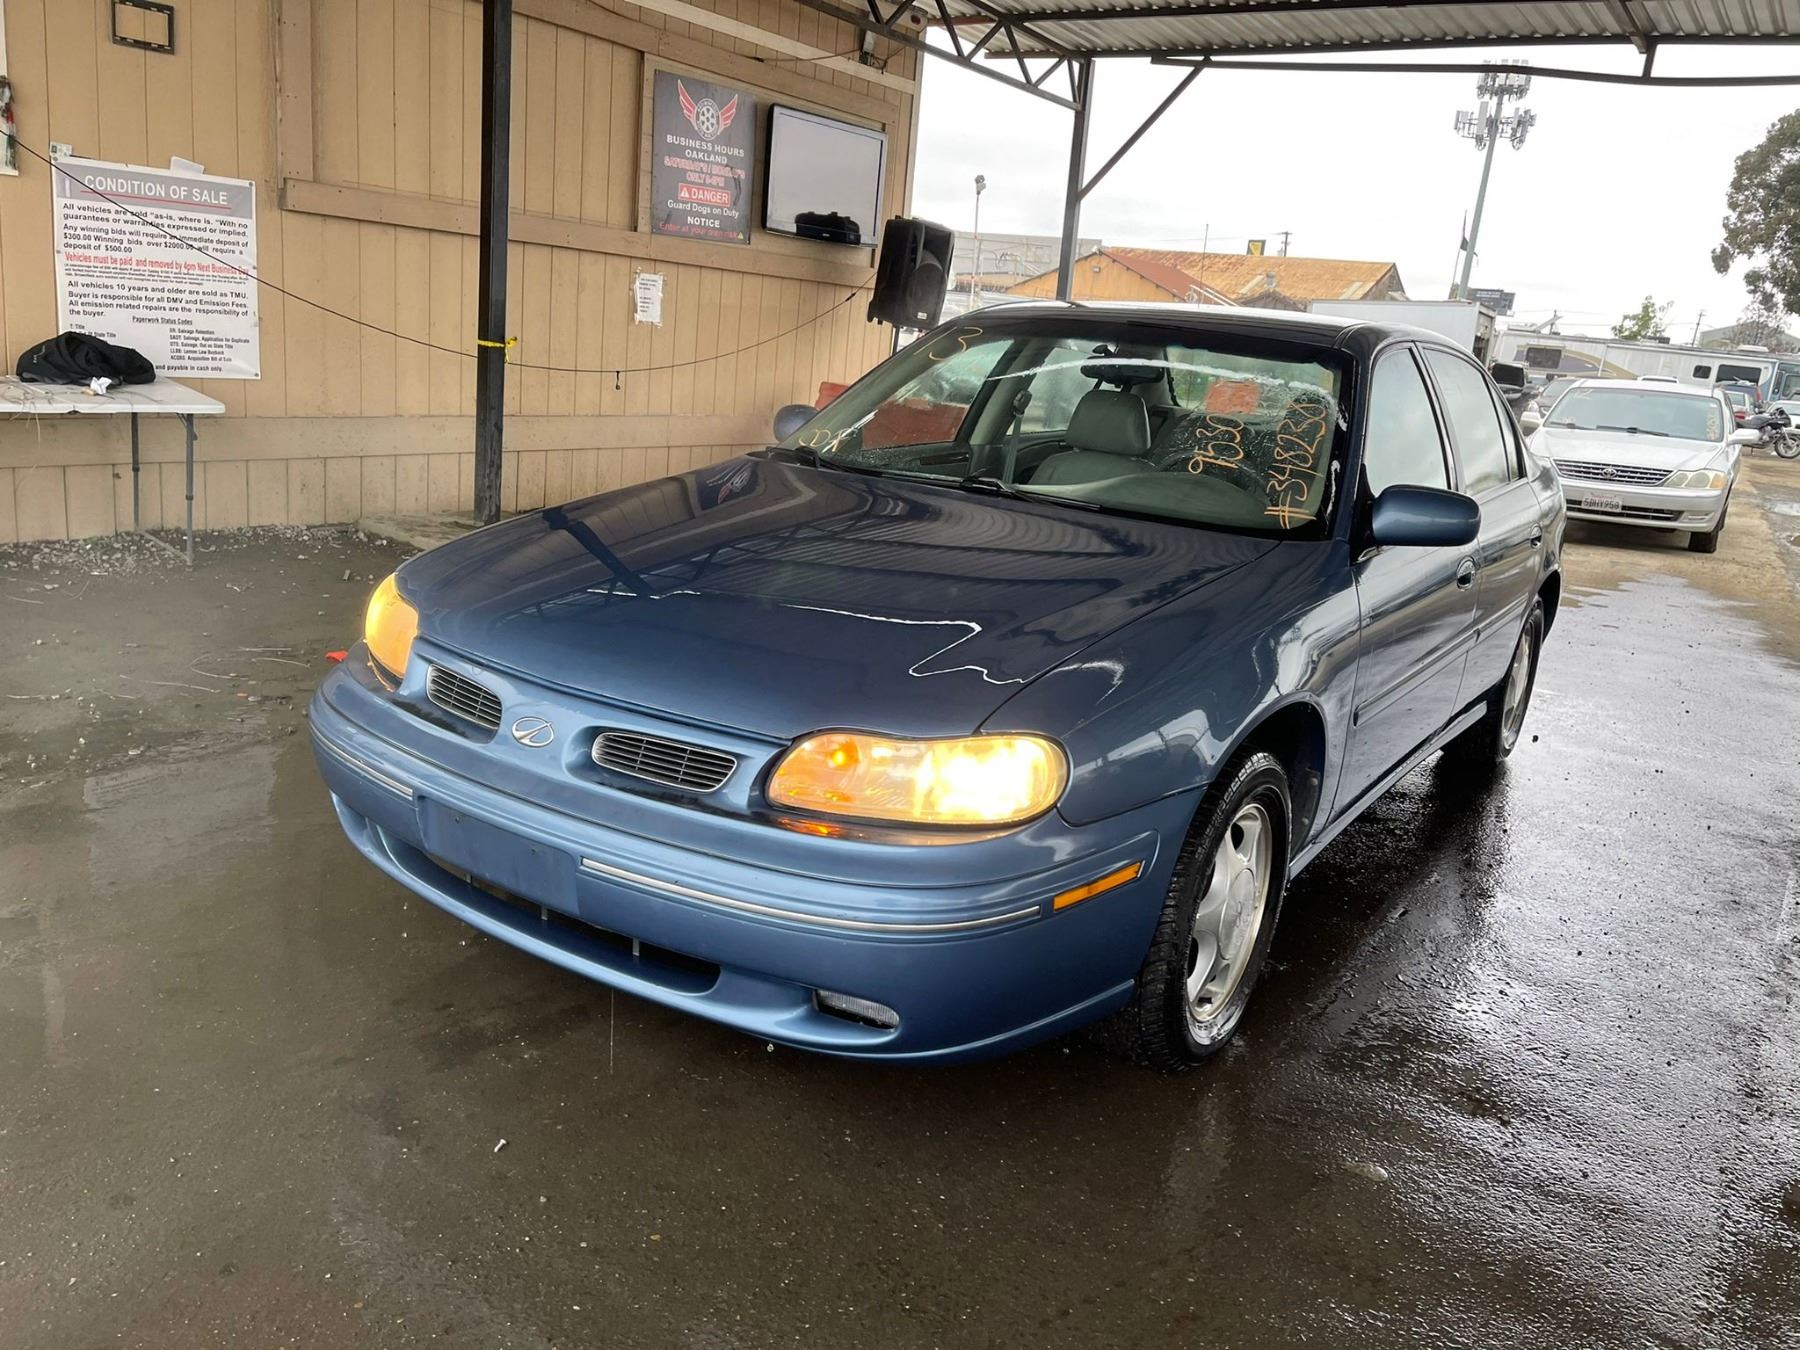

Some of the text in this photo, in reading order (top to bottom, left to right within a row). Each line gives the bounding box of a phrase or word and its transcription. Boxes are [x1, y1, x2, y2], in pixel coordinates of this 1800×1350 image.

[666, 134, 745, 157] BUSINESS HOURS
[685, 149, 727, 164] OAKLAND
[85, 175, 228, 205] CONDITION OF SALE
[691, 188, 729, 203] DANGER
[77, 205, 111, 214] vehicles
[178, 215, 201, 223] where
[667, 199, 690, 210] Guard
[692, 203, 711, 215] Dogs
[723, 207, 739, 219] Duty
[63, 213, 110, 223] guarantees
[122, 219, 165, 228] warranties
[167, 223, 207, 233] expressed
[687, 215, 720, 228] NOTICE
[63, 223, 78, 232] Any
[79, 225, 109, 235] winning
[142, 231, 167, 239] require
[179, 234, 214, 244] immediate
[216, 238, 240, 247] deposit
[63, 232, 92, 241] $300.00
[93, 234, 123, 245] Winning
[212, 247, 236, 255] require
[63, 242, 92, 250] deposit
[104, 244, 132, 253] $500.00
[64, 252, 91, 263] Vehicles
[93, 256, 109, 264] must
[110, 257, 118, 265] be
[119, 257, 132, 266] paid
[135, 259, 147, 267] and
[148, 260, 174, 270] removed
[175, 262, 182, 271] by
[67, 280, 79, 288] All
[80, 281, 114, 290] vehicles
[127, 285, 149, 293] years
[150, 286, 165, 294] and
[68, 290, 90, 300] Buyer
[100, 293, 143, 302] responsible
[166, 296, 184, 304] DMV
[199, 298, 230, 307] Emission
[80, 301, 115, 309] emission
[115, 302, 140, 310] related
[142, 304, 167, 312] repairs
[195, 307, 240, 317] responsibility
[132, 316, 159, 324] Paperwork
